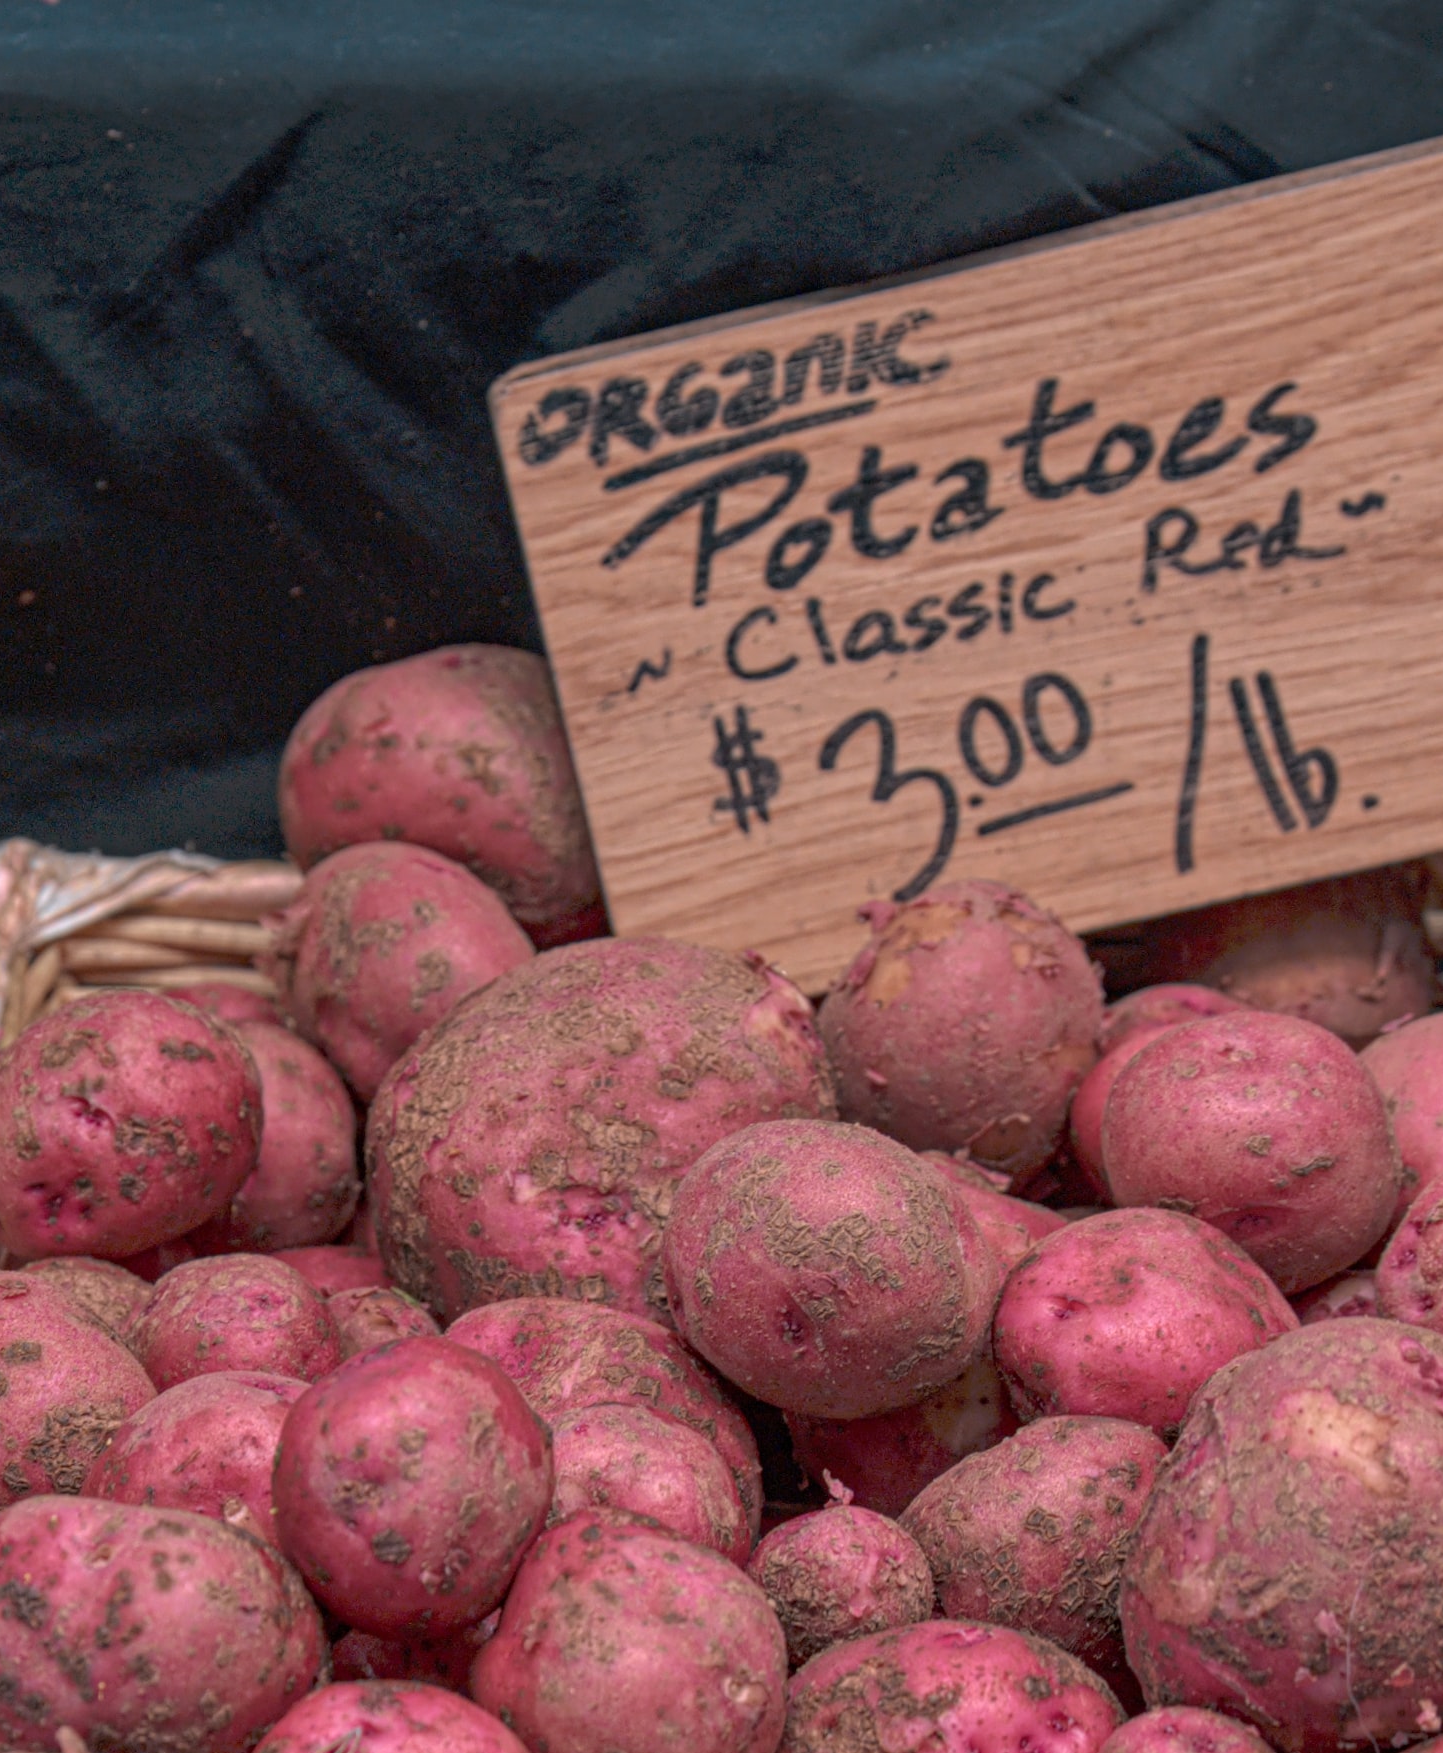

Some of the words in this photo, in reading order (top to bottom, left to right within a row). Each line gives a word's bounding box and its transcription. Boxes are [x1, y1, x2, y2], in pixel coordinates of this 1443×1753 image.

[599, 377, 1320, 609] Potatoes
[725, 570, 1077, 681] Classic
[1140, 484, 1347, 594] Red
[710, 670, 1094, 903] $3.00
